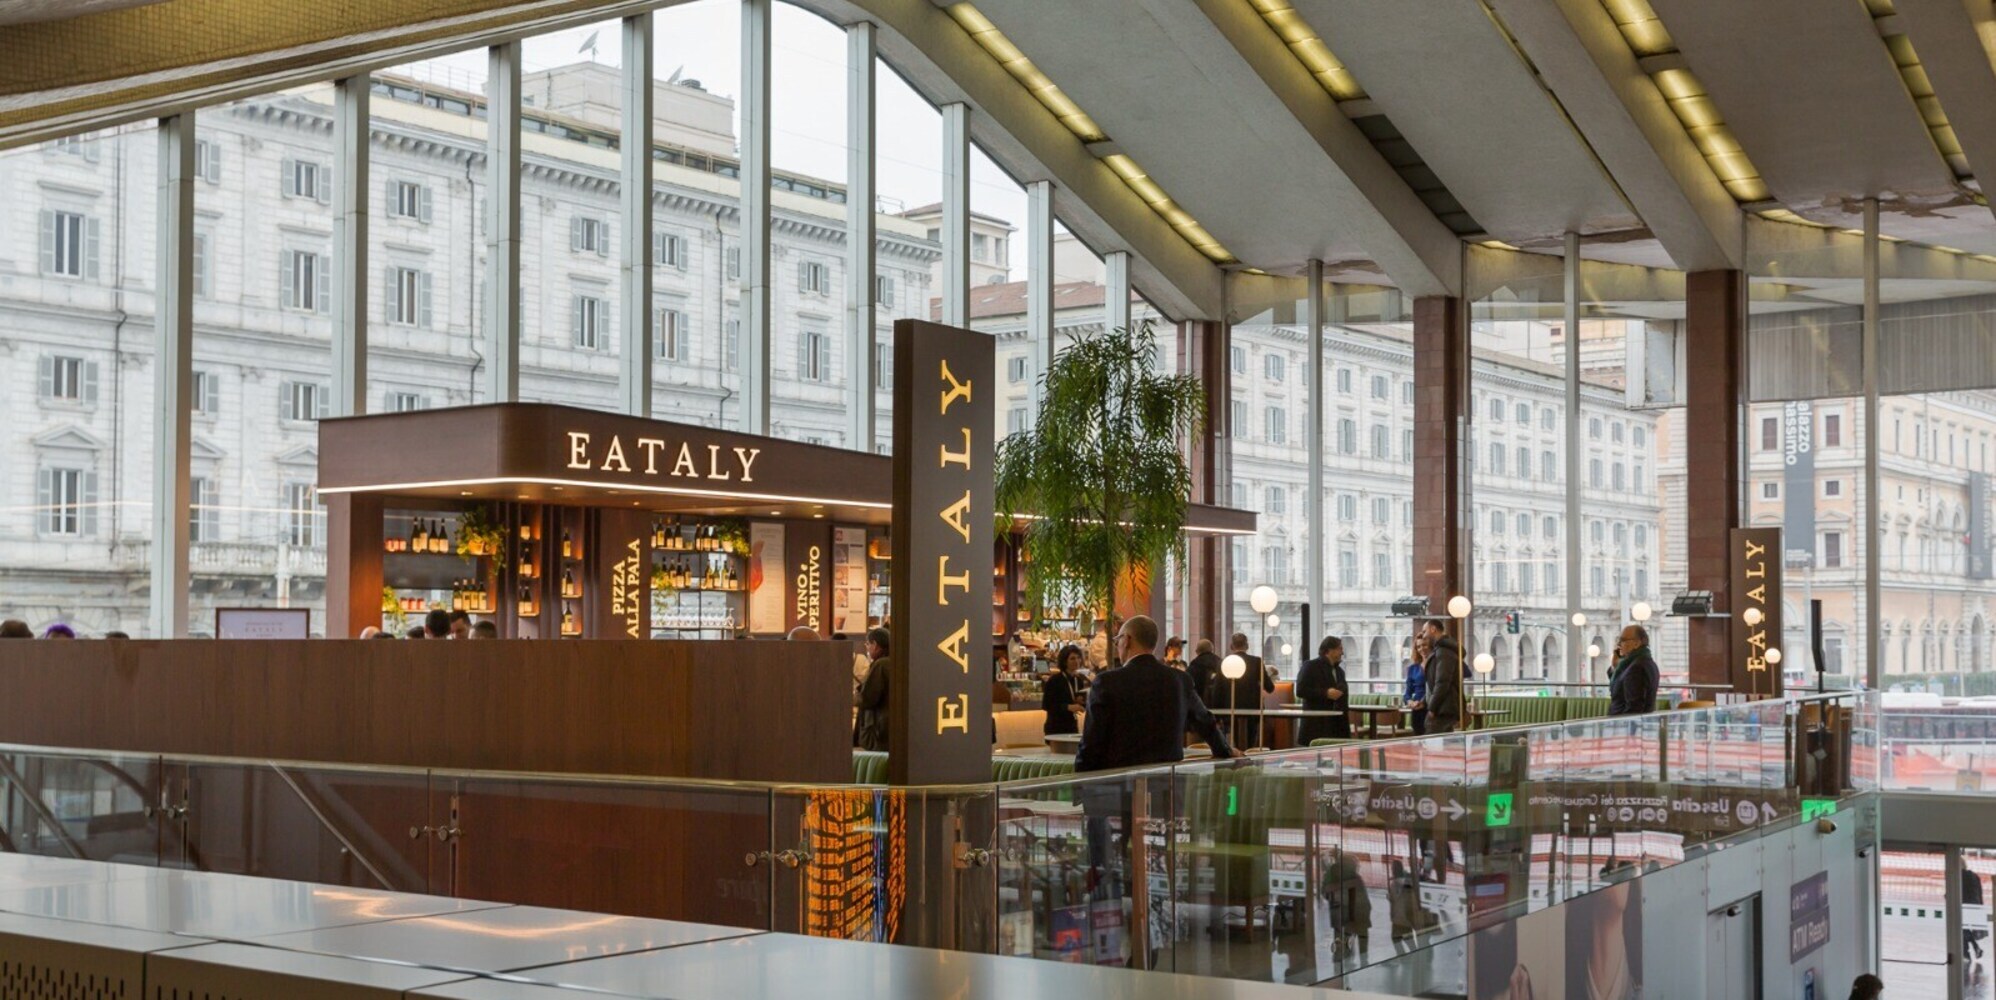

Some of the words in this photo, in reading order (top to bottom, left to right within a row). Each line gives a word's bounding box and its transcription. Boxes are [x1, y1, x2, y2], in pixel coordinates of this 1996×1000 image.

[1797, 401, 1812, 453] alazzo
[566, 431, 761, 482] EATALY
[627, 538, 640, 586] PALA
[937, 359, 972, 735] EATALY
[612, 560, 625, 615] PIZZA
[796, 573, 808, 620] VINO
[626, 589, 640, 639] ALLA
